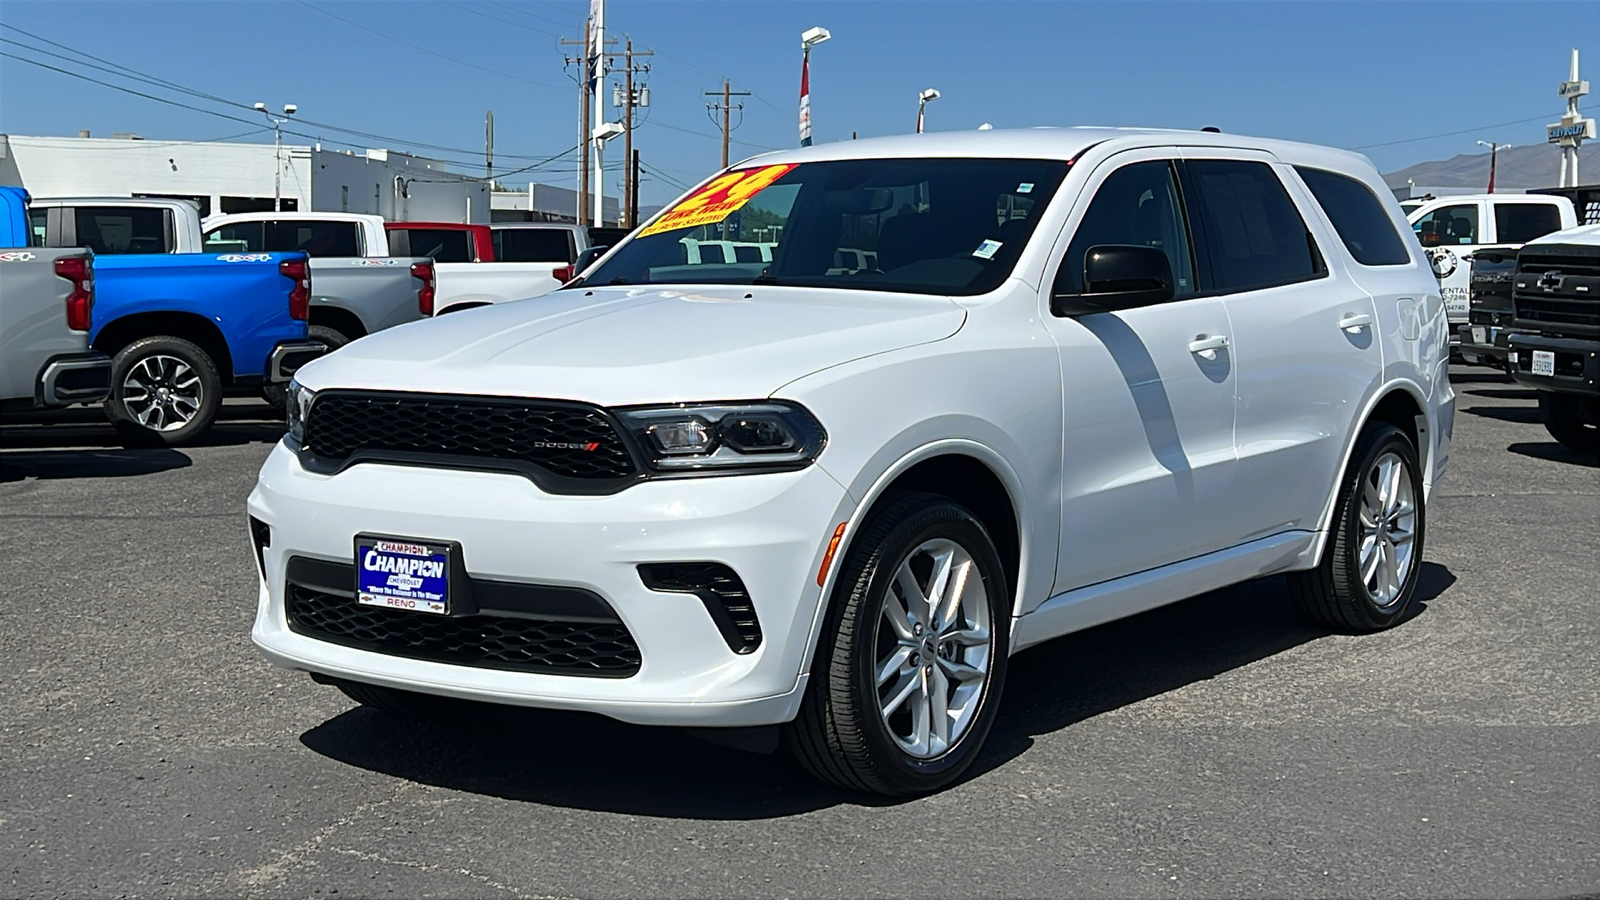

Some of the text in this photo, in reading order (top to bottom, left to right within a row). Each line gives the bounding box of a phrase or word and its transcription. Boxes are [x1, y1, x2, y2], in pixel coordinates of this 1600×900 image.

[672, 164, 789, 212] 24
[534, 441, 589, 449] DODGE
[381, 542, 424, 554] CHAMPION
[364, 550, 444, 578] CHAMPION
[389, 576, 420, 586] CHEVROLET
[387, 598, 416, 608] RENO
